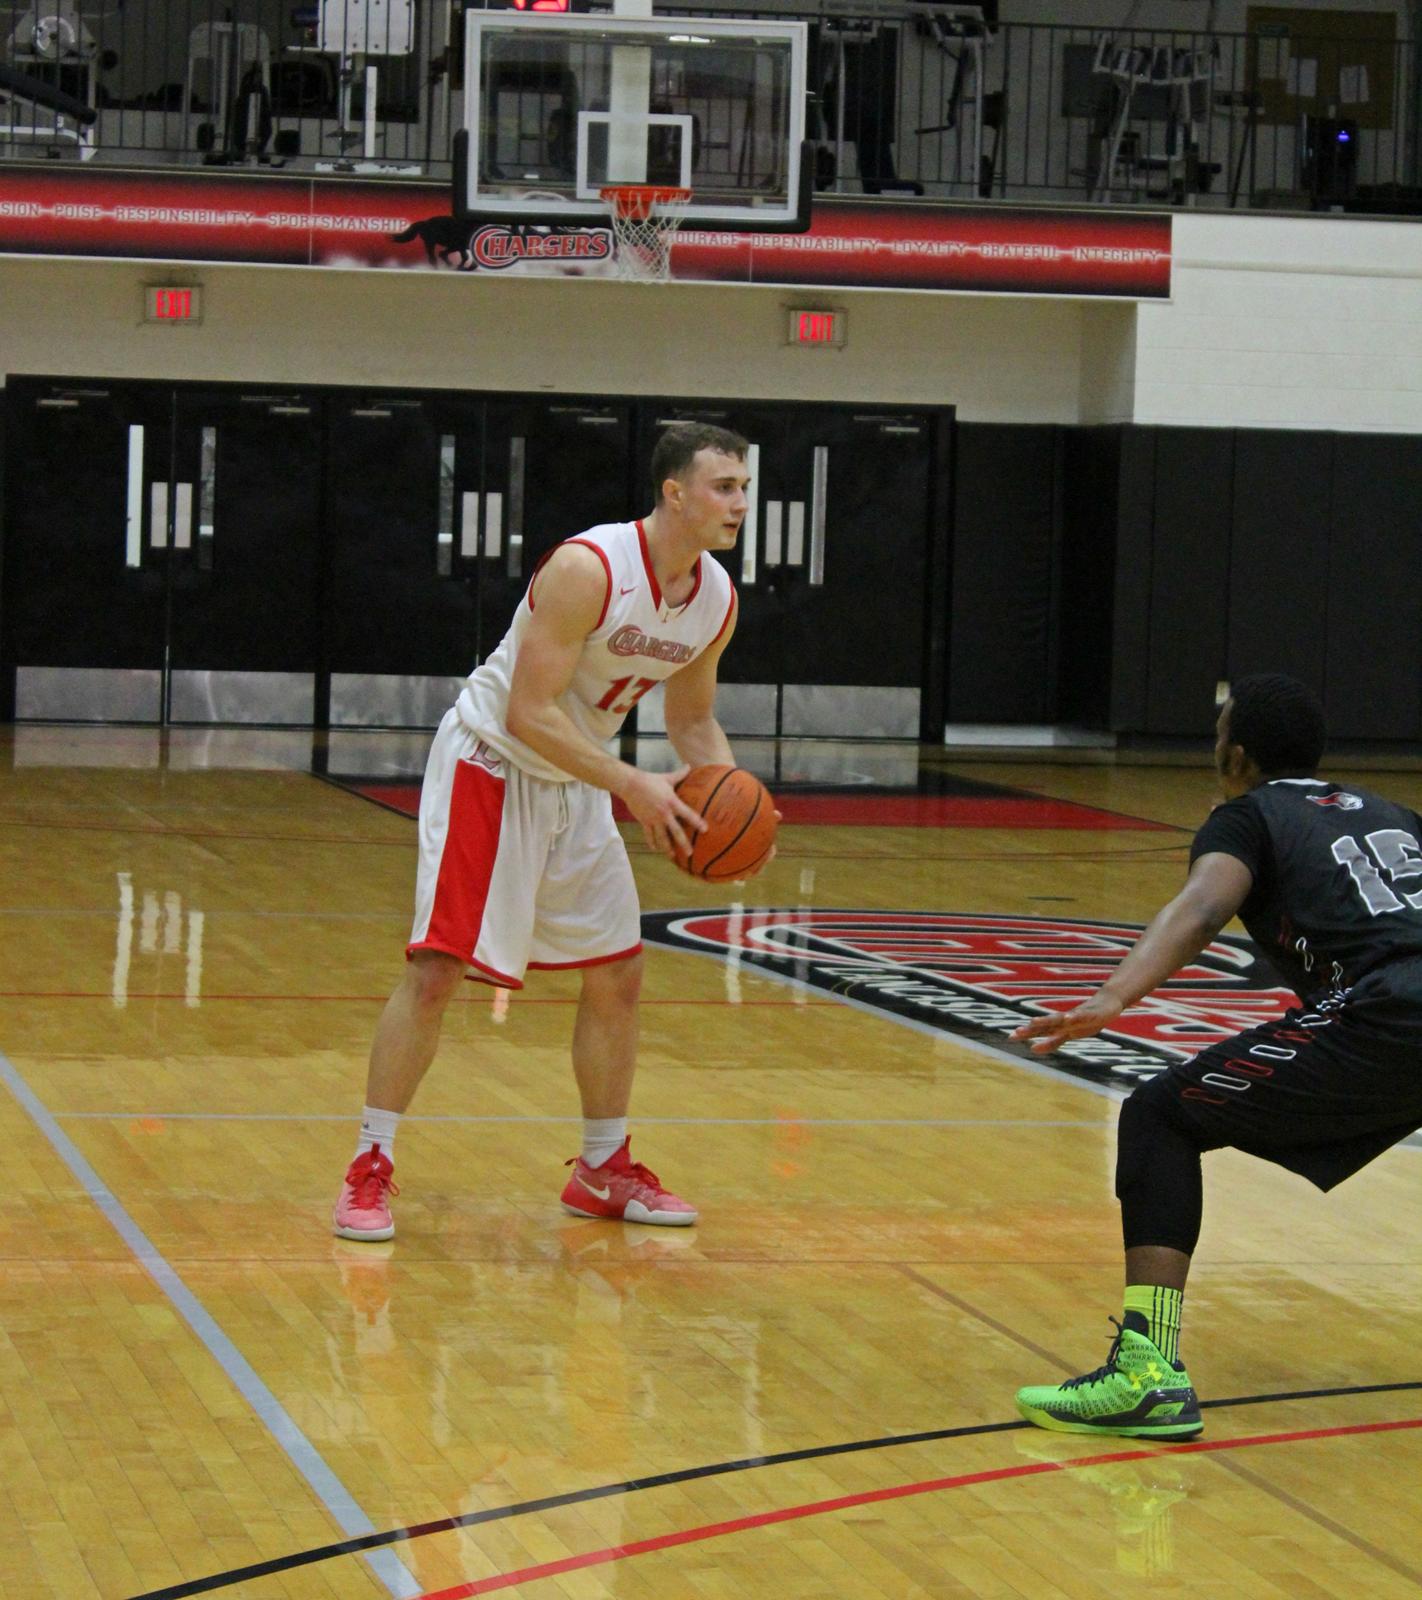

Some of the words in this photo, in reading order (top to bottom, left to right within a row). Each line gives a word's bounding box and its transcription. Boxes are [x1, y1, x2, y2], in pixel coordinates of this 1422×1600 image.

[54, 203, 101, 219] POISE
[115, 206, 254, 225] RESPONSIBILITY
[267, 213, 410, 232] SPORTSMANSHIP
[472, 226, 610, 268] CHARGERS
[667, 230, 738, 247] OURAGE
[751, 234, 880, 252] DEPENDABILITY
[892, 240, 967, 255] LOYALTY
[979, 243, 1059, 260] GRATEFUL
[1072, 246, 1161, 263] INTEGRITY
[156, 289, 192, 318] EXIT
[799, 312, 833, 342] EXIT
[595, 675, 660, 714] 13
